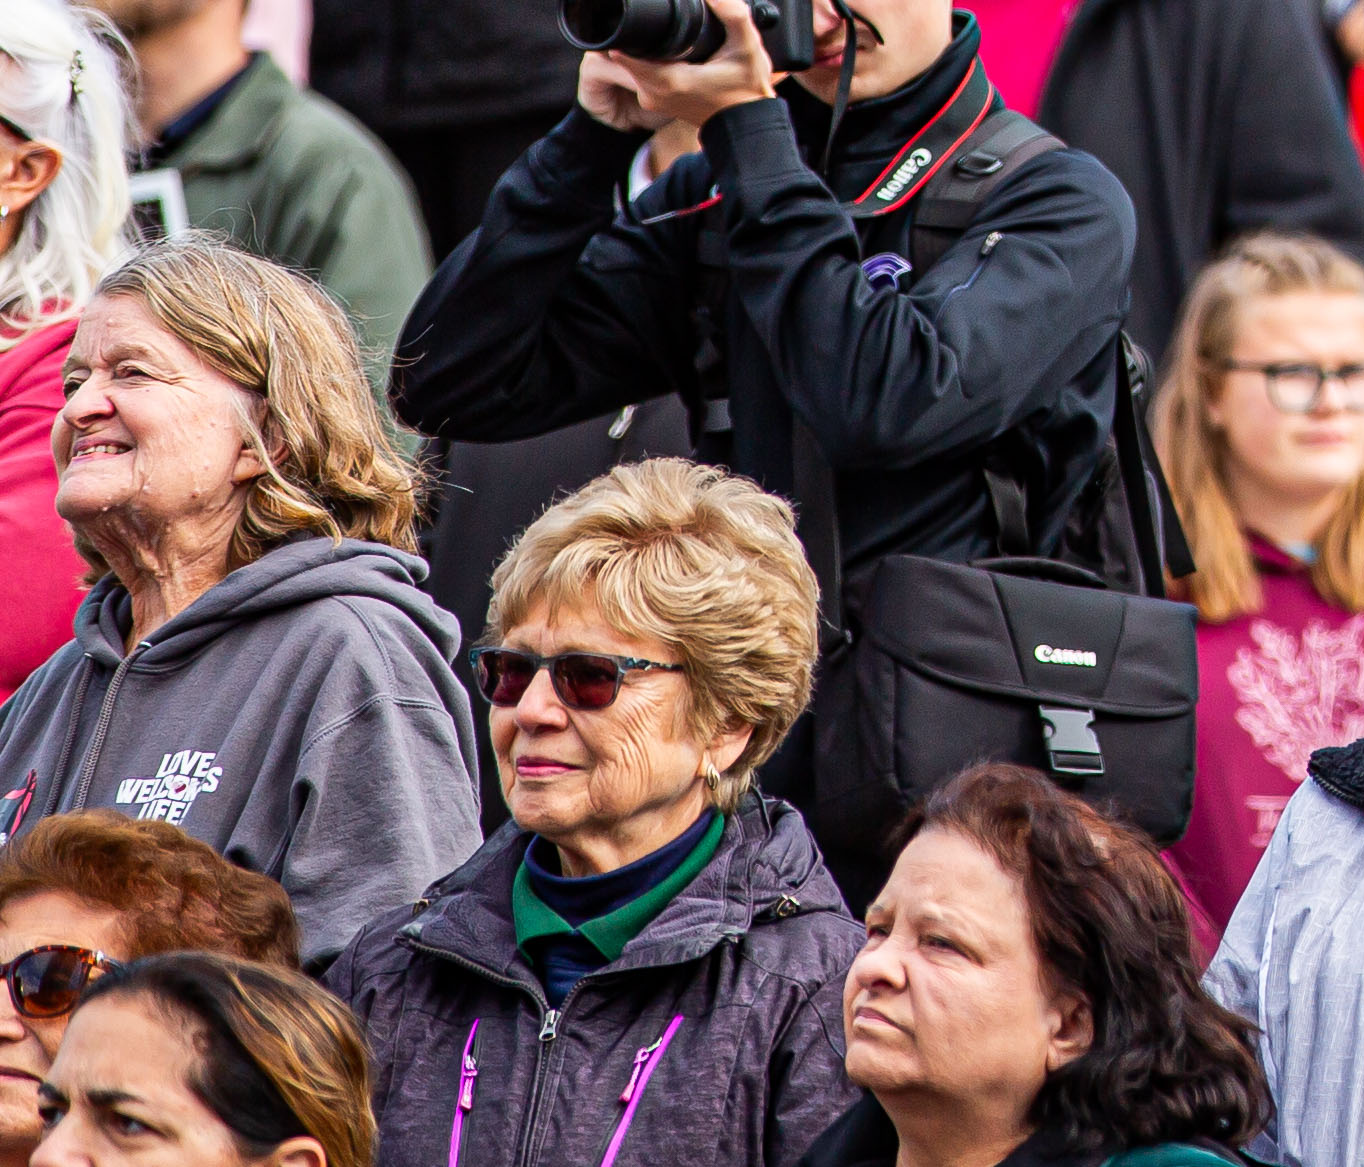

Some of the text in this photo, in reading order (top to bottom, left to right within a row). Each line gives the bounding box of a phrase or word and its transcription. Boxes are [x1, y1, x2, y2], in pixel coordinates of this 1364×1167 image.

[876, 147, 933, 201] Canon
[1034, 644, 1097, 668] Canon
[155, 750, 217, 779] LOVE
